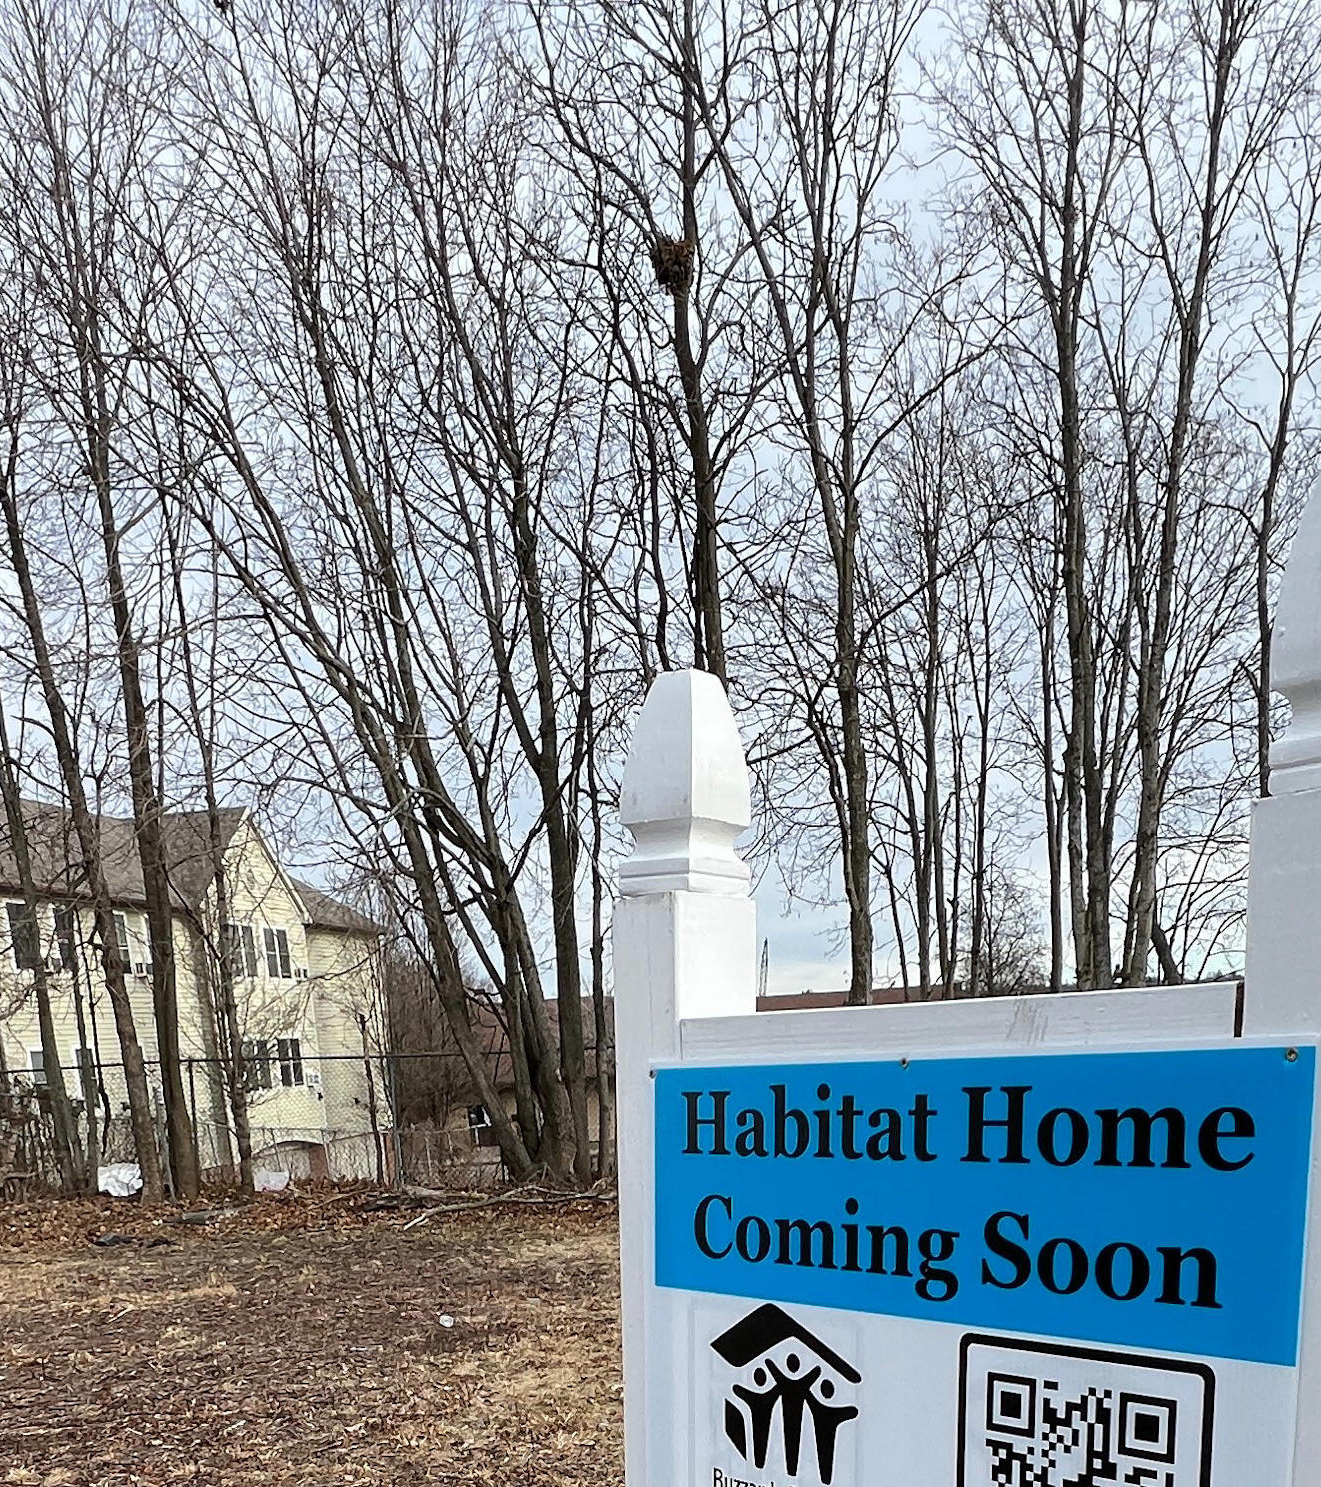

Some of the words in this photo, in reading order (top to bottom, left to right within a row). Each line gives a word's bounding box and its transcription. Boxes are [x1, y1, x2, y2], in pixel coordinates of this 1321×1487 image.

[680, 1082, 939, 1164] Habitat
[959, 1084, 1257, 1172] Home
[693, 1194, 961, 1303] Coming
[981, 1210, 1224, 1310] Soon
